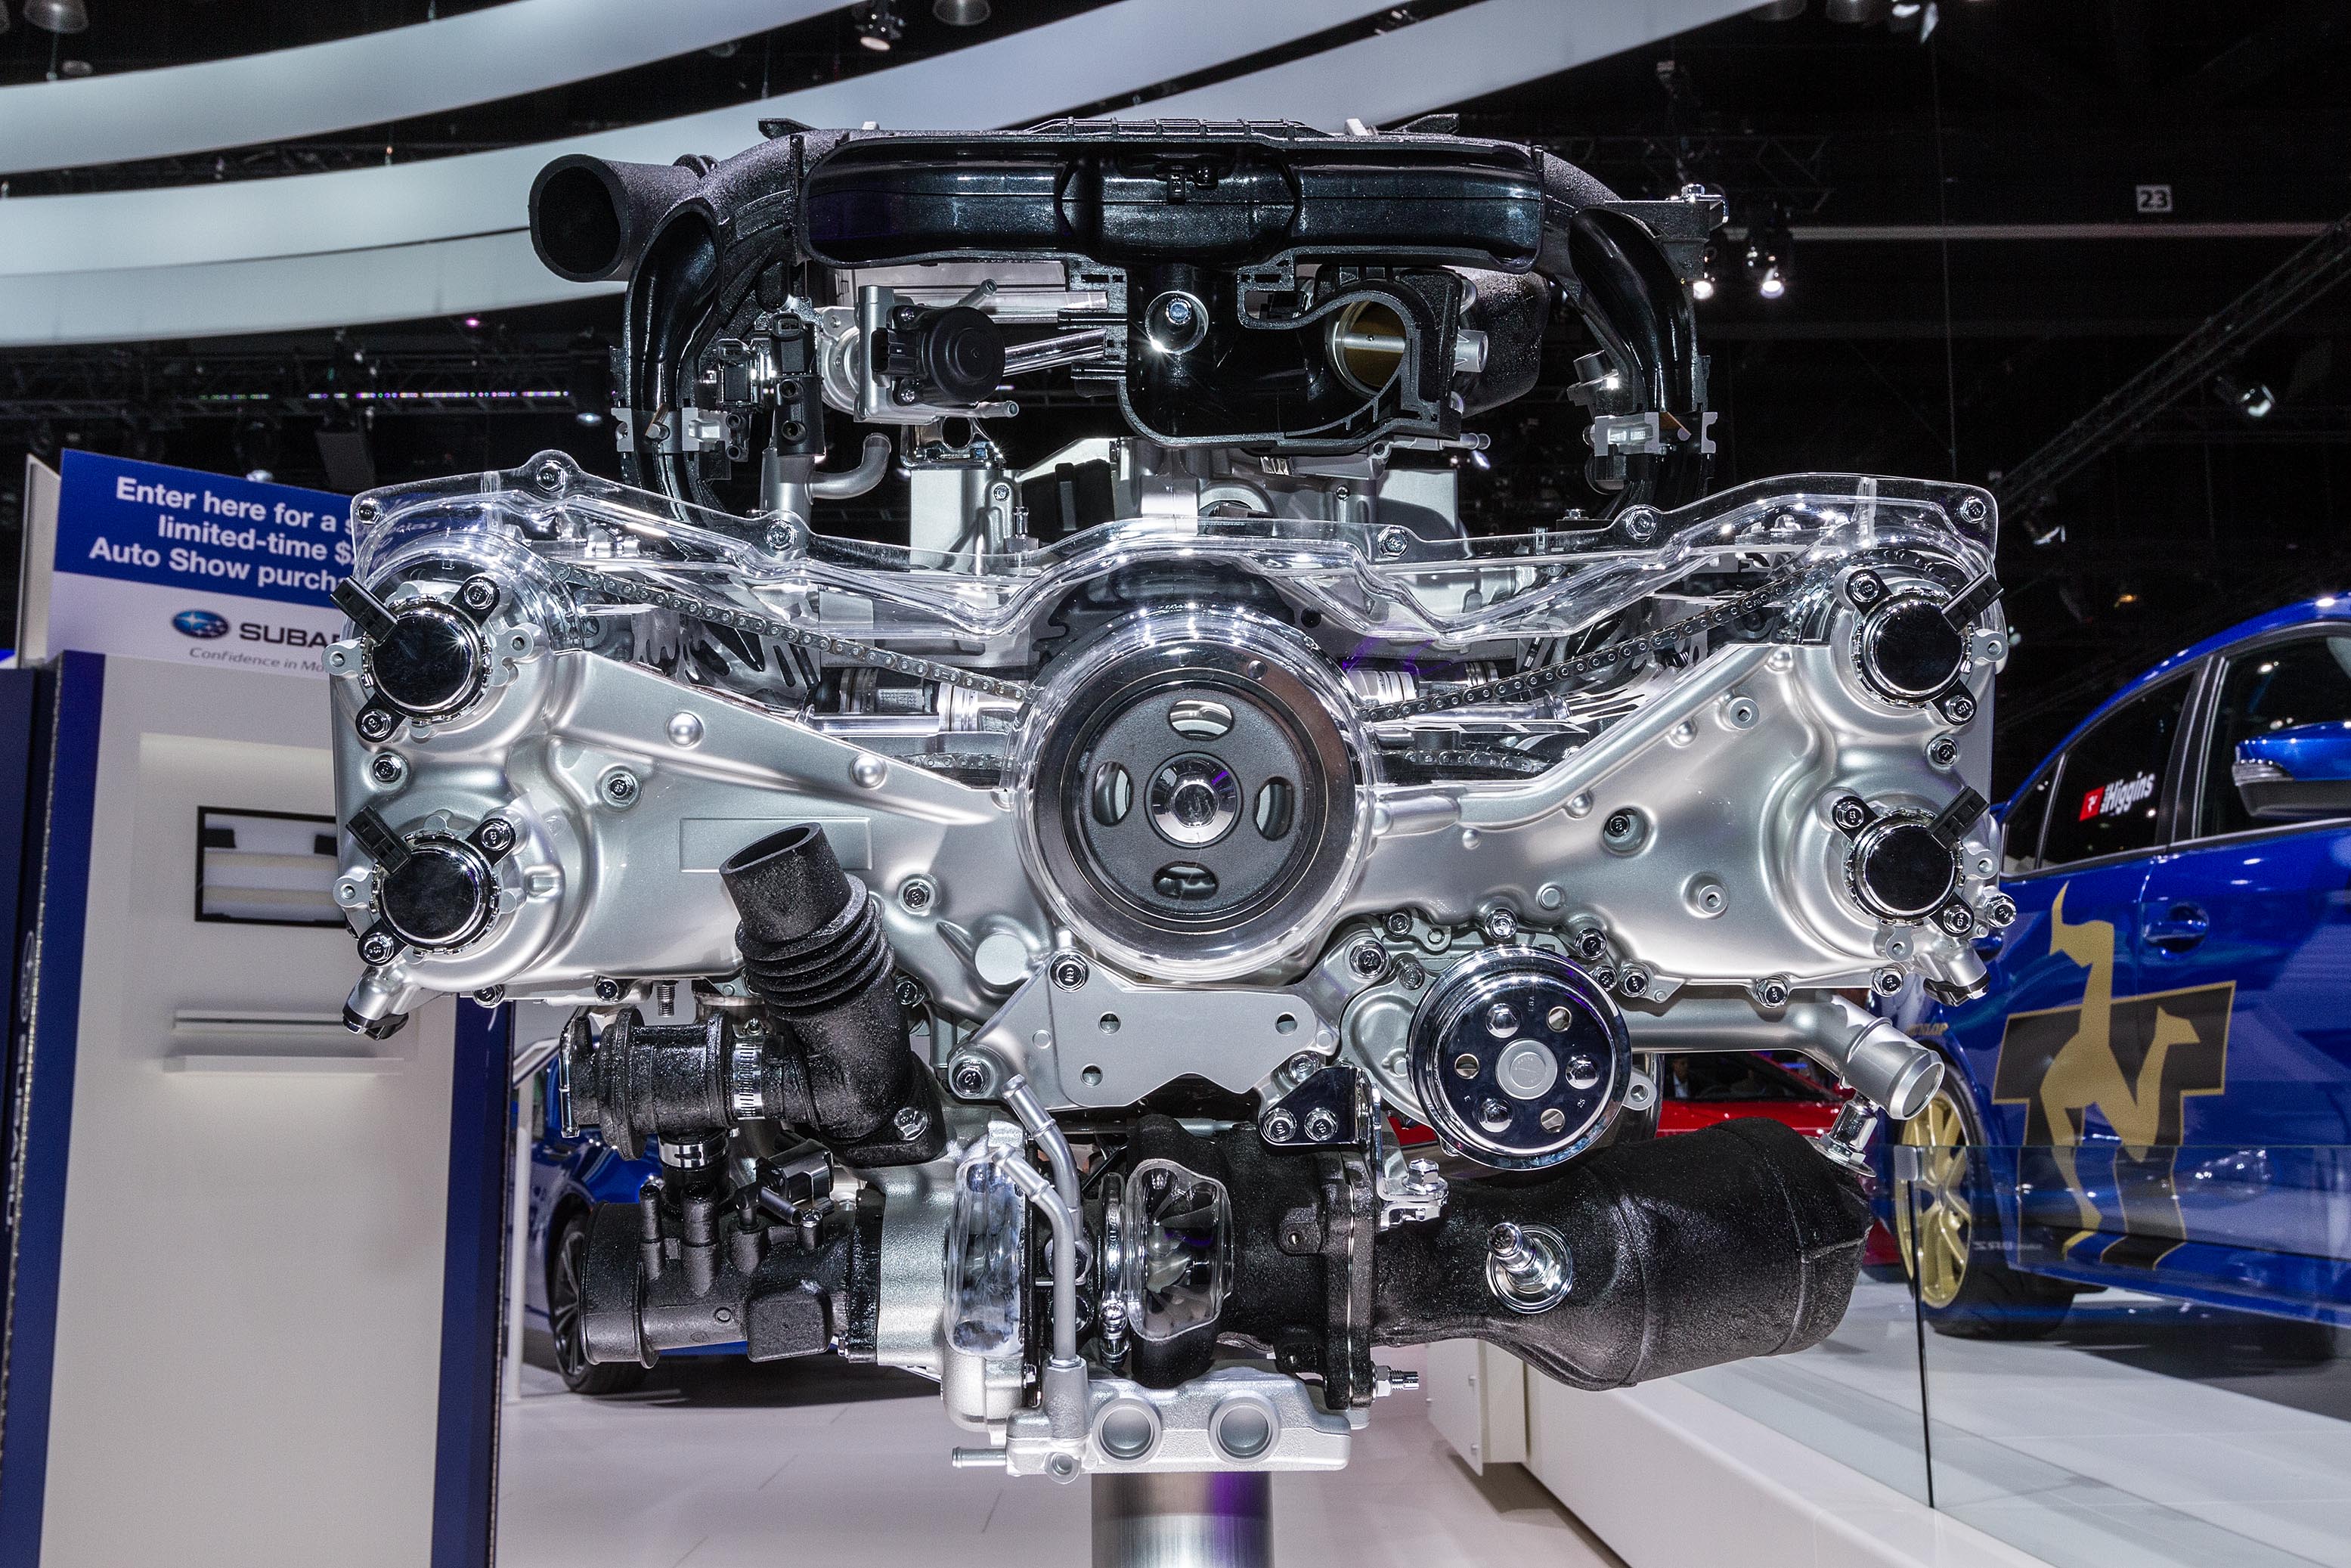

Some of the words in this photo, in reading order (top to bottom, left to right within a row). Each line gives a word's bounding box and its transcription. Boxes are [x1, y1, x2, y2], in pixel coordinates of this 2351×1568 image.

[2140, 189, 2168, 208] 23
[116, 476, 197, 510] Enter
[203, 490, 267, 522] here
[274, 502, 314, 528] for
[320, 514, 336, 533] a
[158, 514, 328, 561] limited-time
[88, 536, 161, 568] Auto
[169, 547, 251, 580] Show
[258, 566, 345, 592] purch
[239, 622, 340, 648] SUBA
[189, 647, 280, 668] Confidence
[284, 658, 297, 671] in
[2104, 771, 2155, 815] Higgins
